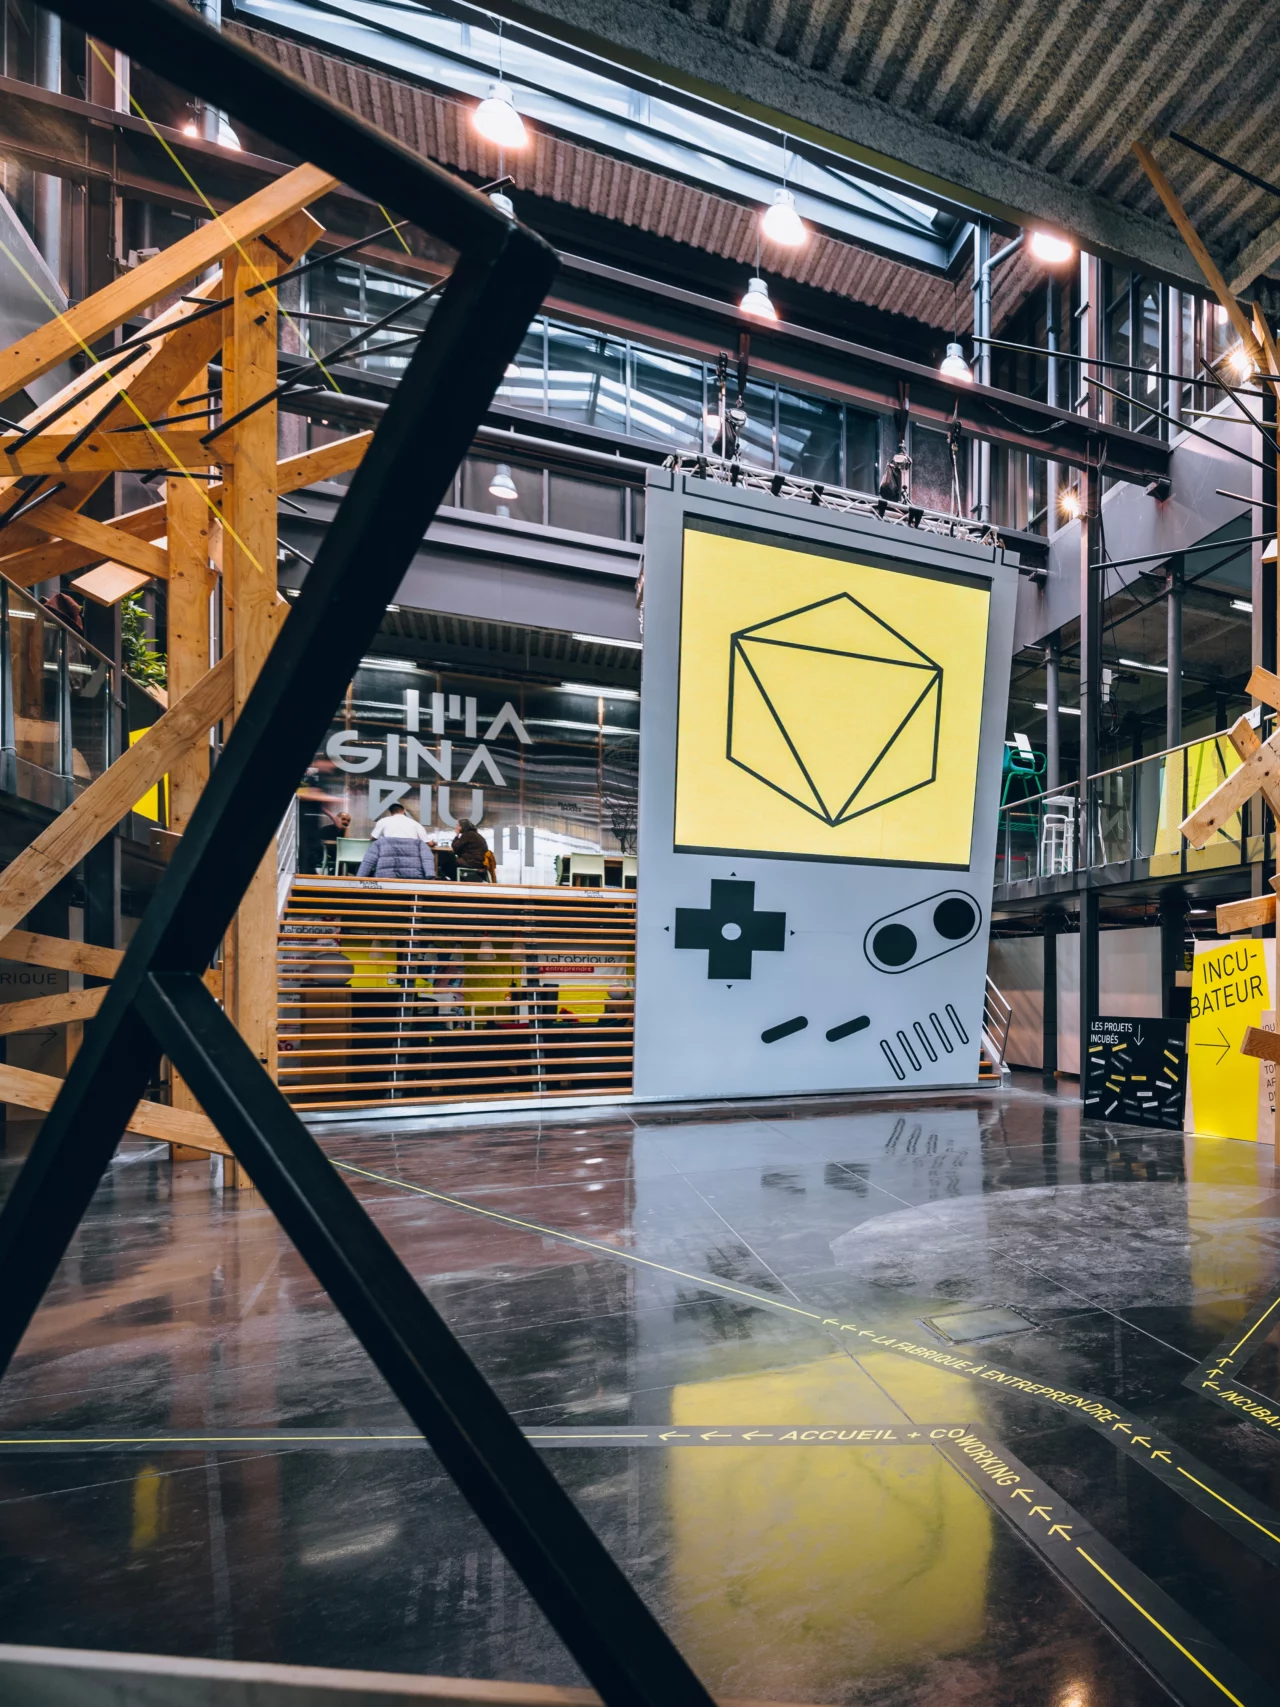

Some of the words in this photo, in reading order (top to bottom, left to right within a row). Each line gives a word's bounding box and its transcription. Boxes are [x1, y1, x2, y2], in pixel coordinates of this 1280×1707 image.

[1202, 948, 1258, 984] INCU-
[1190, 975, 1264, 1019] BATEUR
[1090, 1033, 1119, 1044] INCUBÉS
[1091, 1021, 1103, 1031] LES
[1104, 1022, 1133, 1032] PROJETS
[871, 1335, 892, 1346] LA
[893, 1341, 971, 1372] FABRIQUE
[966, 1363, 988, 1375] À
[980, 1370, 1120, 1424] ENTREPRENDRE
[778, 1430, 898, 1441] ACCUEIL
[929, 1428, 1021, 1486] COWORKING
